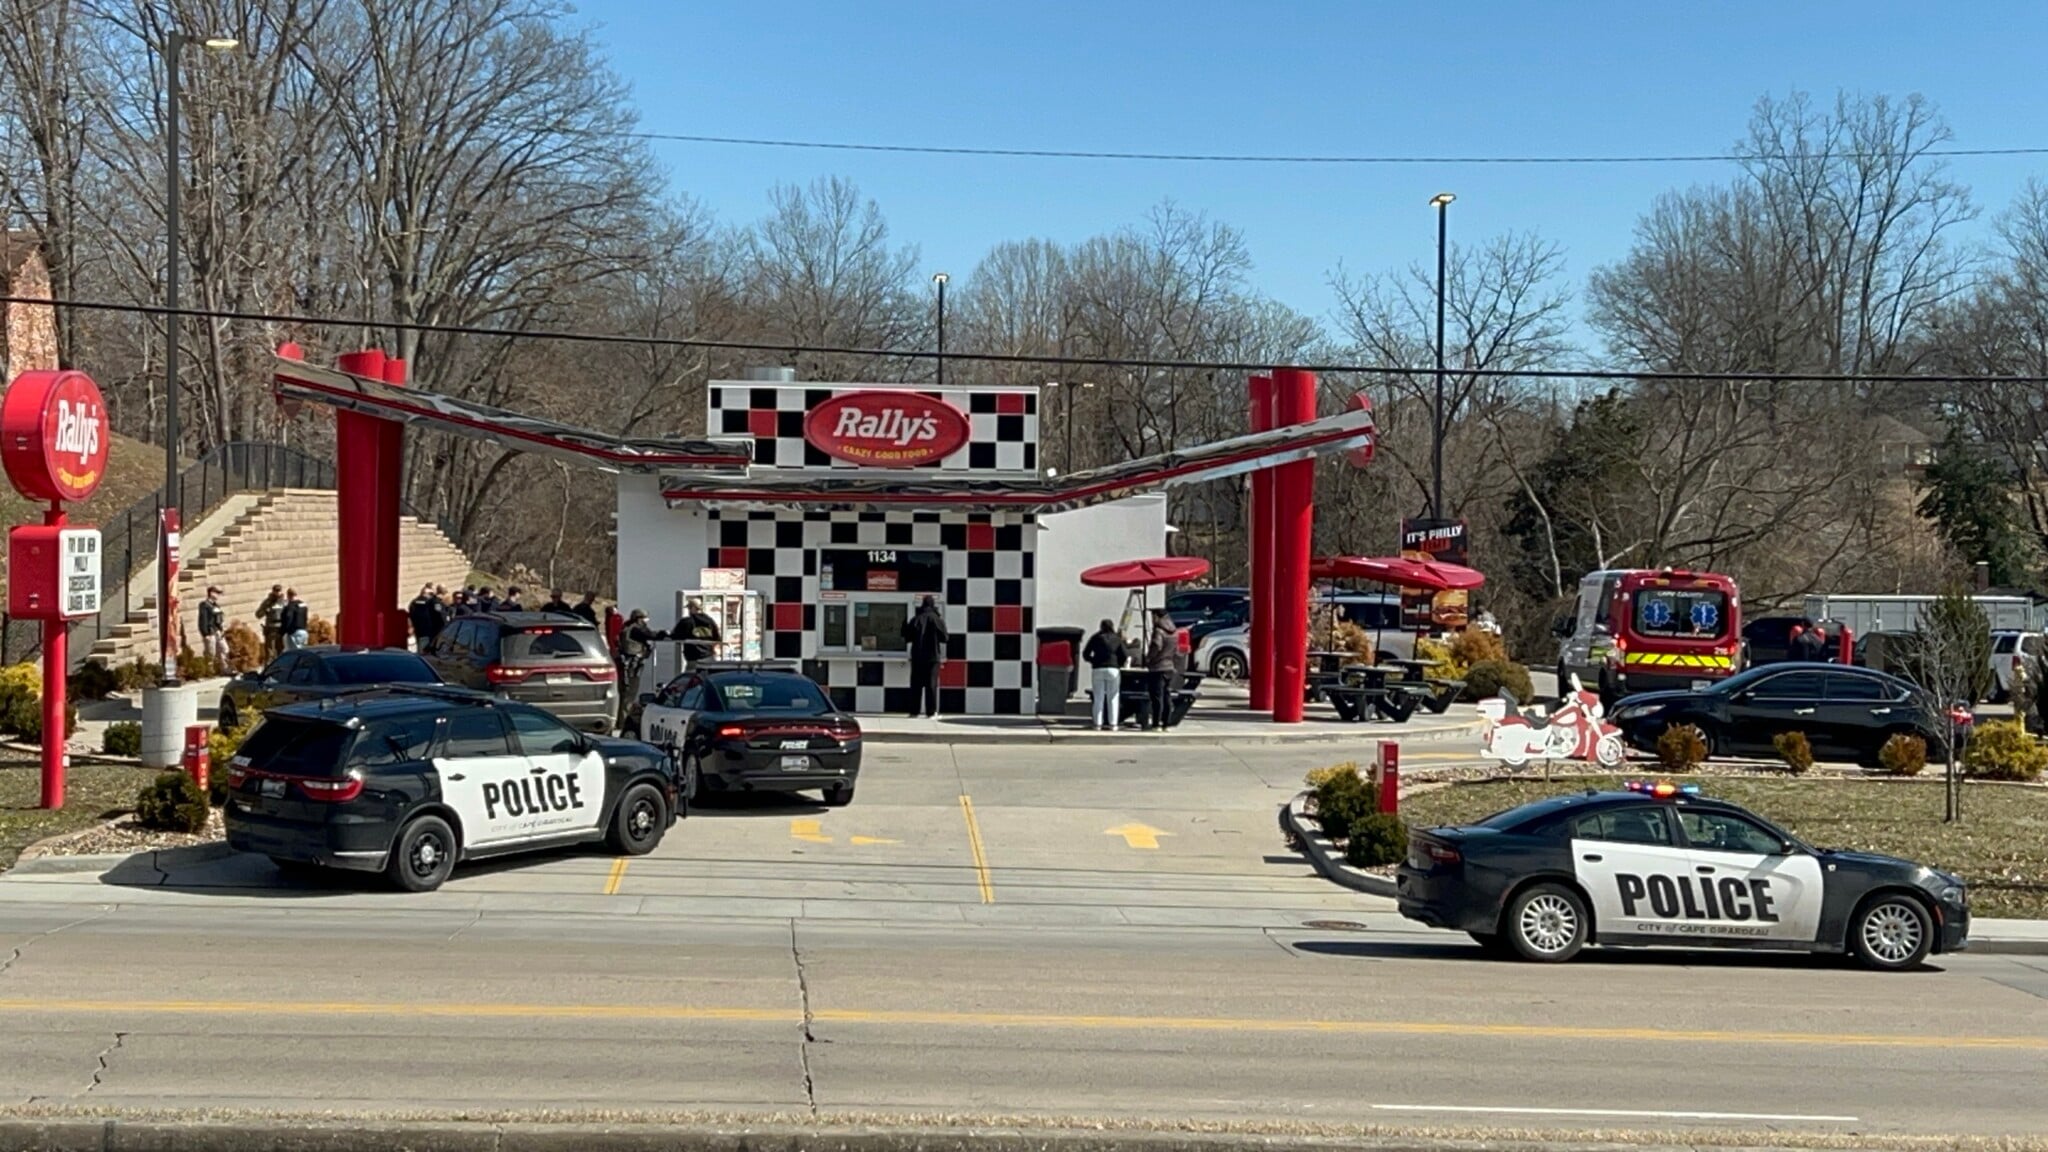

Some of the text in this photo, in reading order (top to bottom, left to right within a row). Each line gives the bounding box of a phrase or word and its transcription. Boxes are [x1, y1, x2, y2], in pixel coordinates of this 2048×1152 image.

[55, 399, 99, 465] Rally's
[833, 407, 938, 445] Rally's
[843, 445, 928, 460] CRAZY GOOD FOOD
[1407, 525, 1462, 543] IT'S PHILLY
[867, 550, 897, 563] 1134
[779, 739, 809, 749] POLICE
[482, 772, 584, 819] POLICE
[1615, 873, 1780, 922] POLICE
[1637, 923, 1661, 931] CITY
[1679, 925, 1705, 933] CAPE
[1709, 927, 1769, 936] GIRARDEAU
